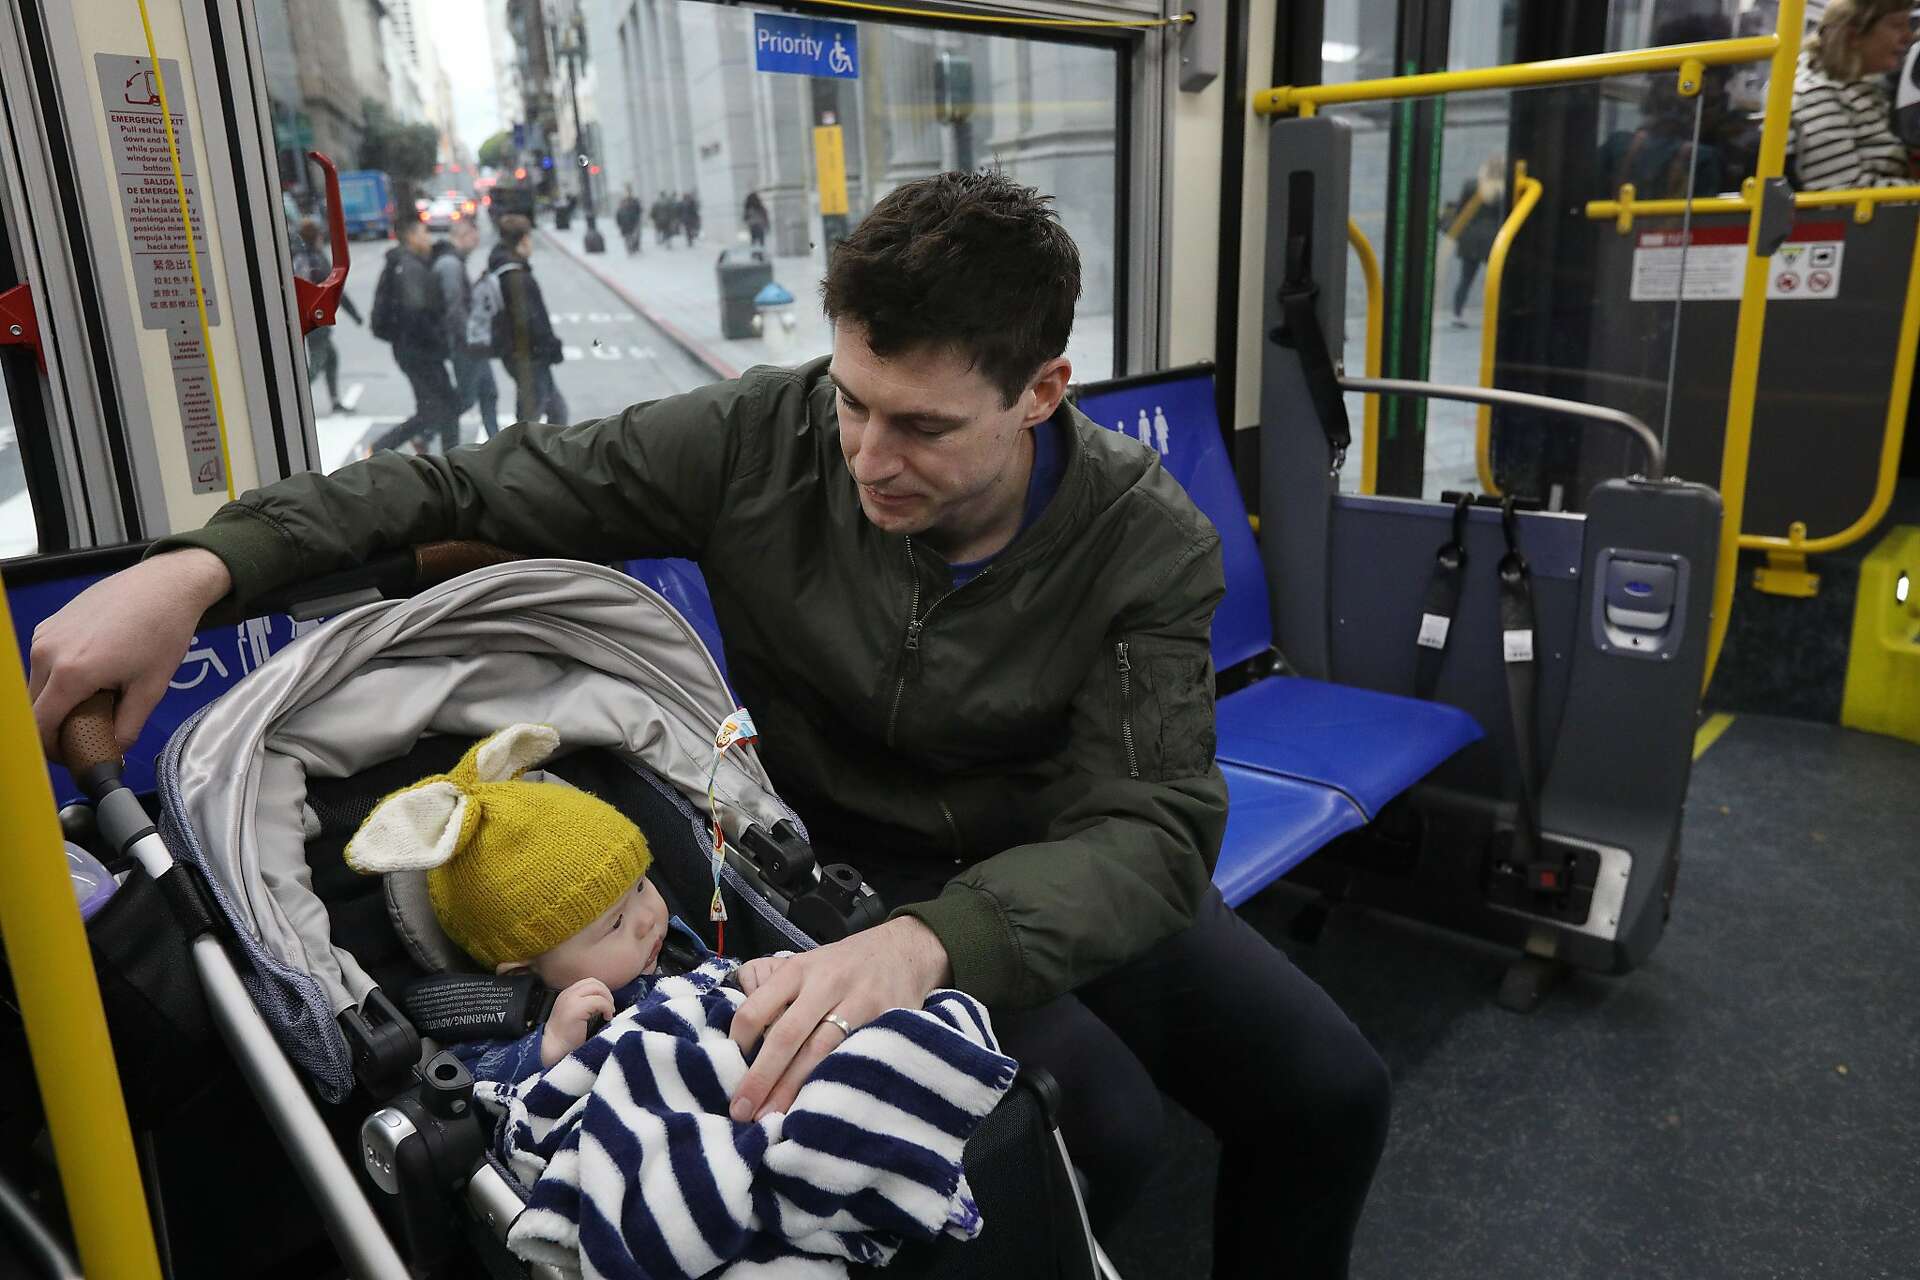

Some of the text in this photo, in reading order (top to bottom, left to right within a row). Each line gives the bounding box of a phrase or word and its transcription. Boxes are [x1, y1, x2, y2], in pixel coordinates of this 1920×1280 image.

[758, 28, 823, 61] Priority
[111, 115, 163, 125] EMERGENCY
[120, 125, 180, 135] Pull red hanle
[163, 137, 180, 145] hd
[149, 146, 180, 154] pushig
[143, 164, 171, 172] bottom
[143, 178, 176, 186] SALIDA
